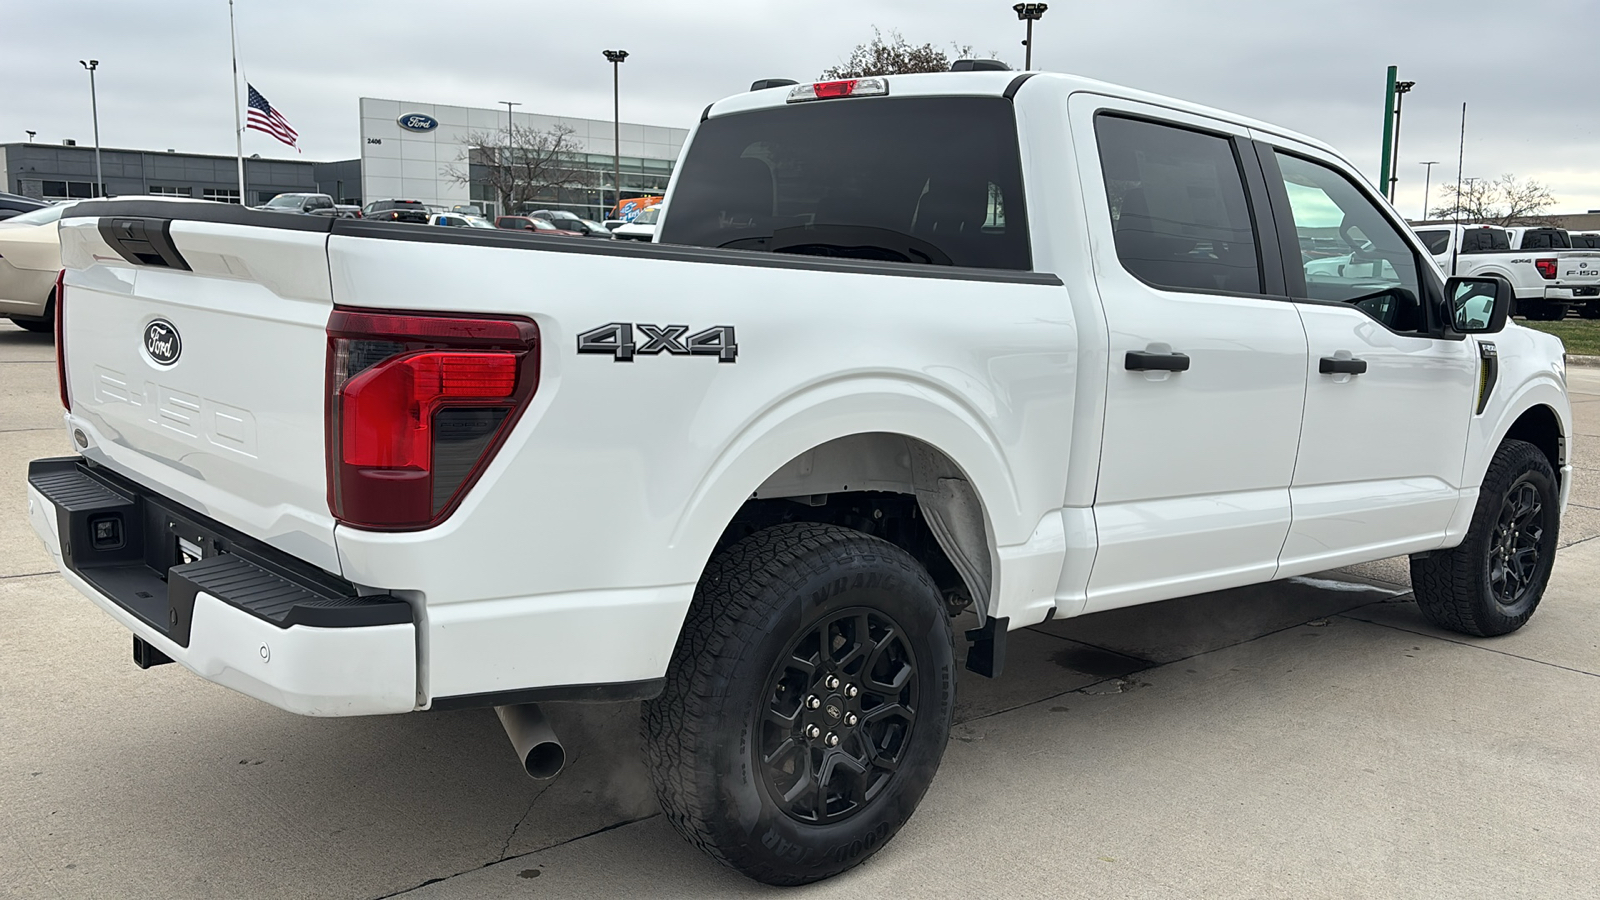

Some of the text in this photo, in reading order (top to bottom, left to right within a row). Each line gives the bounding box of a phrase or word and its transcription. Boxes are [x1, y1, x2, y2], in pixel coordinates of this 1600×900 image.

[406, 115, 431, 130] Ford
[367, 137, 382, 146] 2406
[149, 327, 173, 358] Ford
[93, 364, 259, 459] F-150
